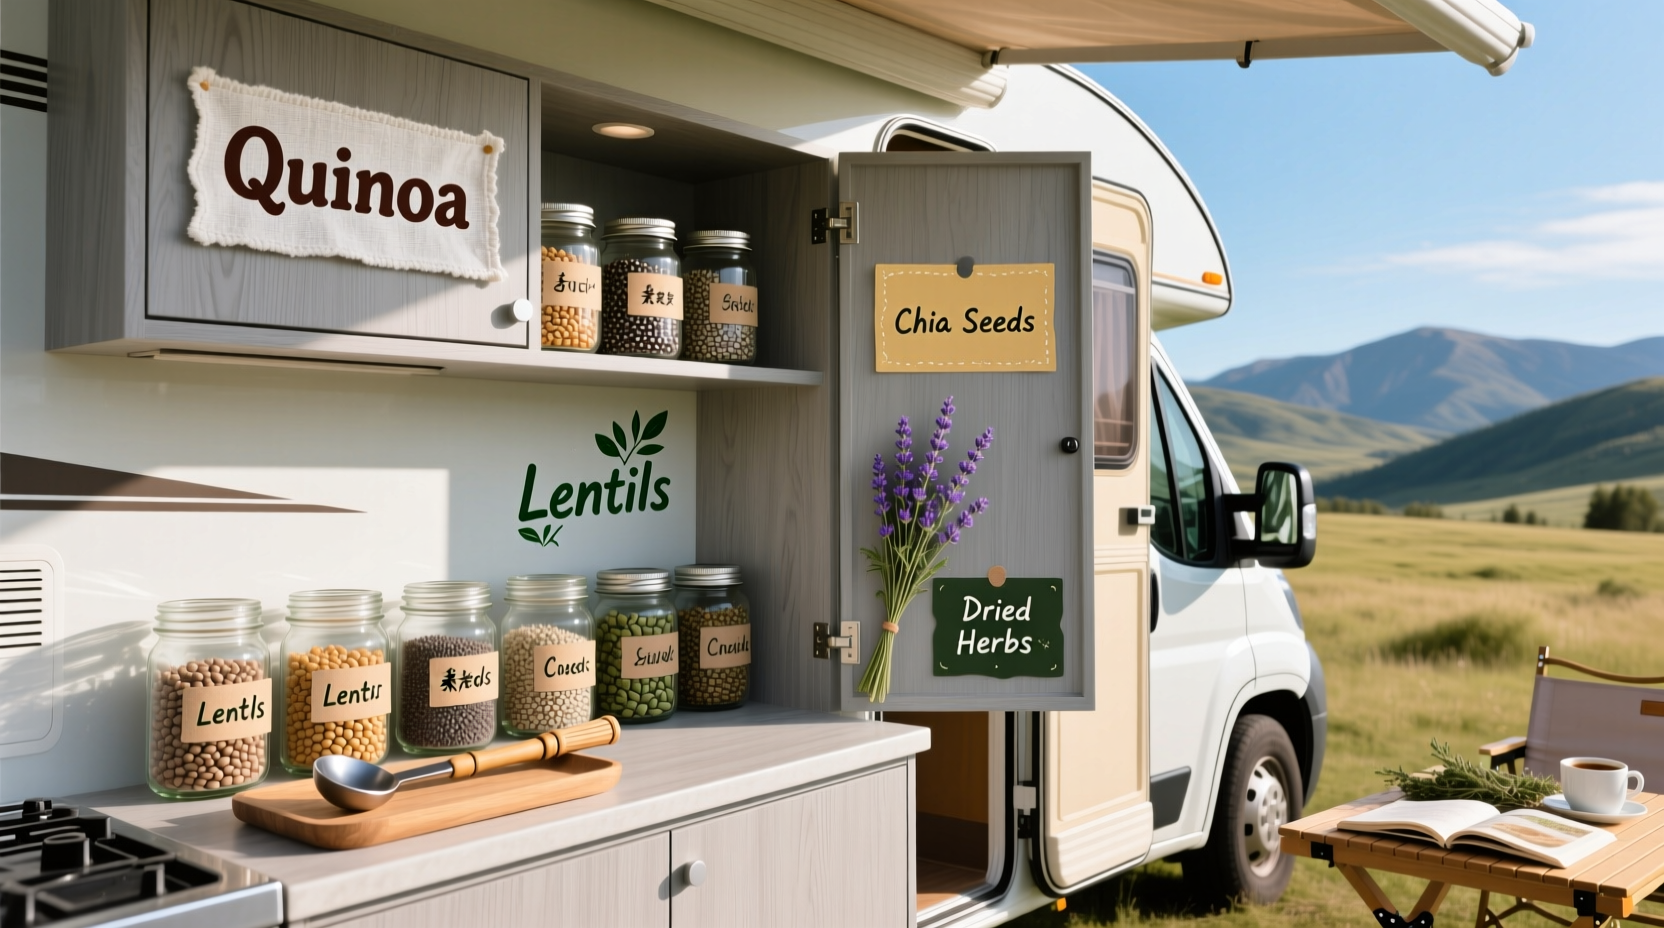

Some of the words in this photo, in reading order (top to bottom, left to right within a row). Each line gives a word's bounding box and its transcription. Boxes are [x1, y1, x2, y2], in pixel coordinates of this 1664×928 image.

[224, 125, 470, 230] Quinoa
[895, 306, 952, 334] Chia
[962, 306, 1035, 333] Seeds
[518, 460, 671, 522] Lentils
[962, 595, 1032, 622] Dried
[957, 628, 1032, 655] Herbs
